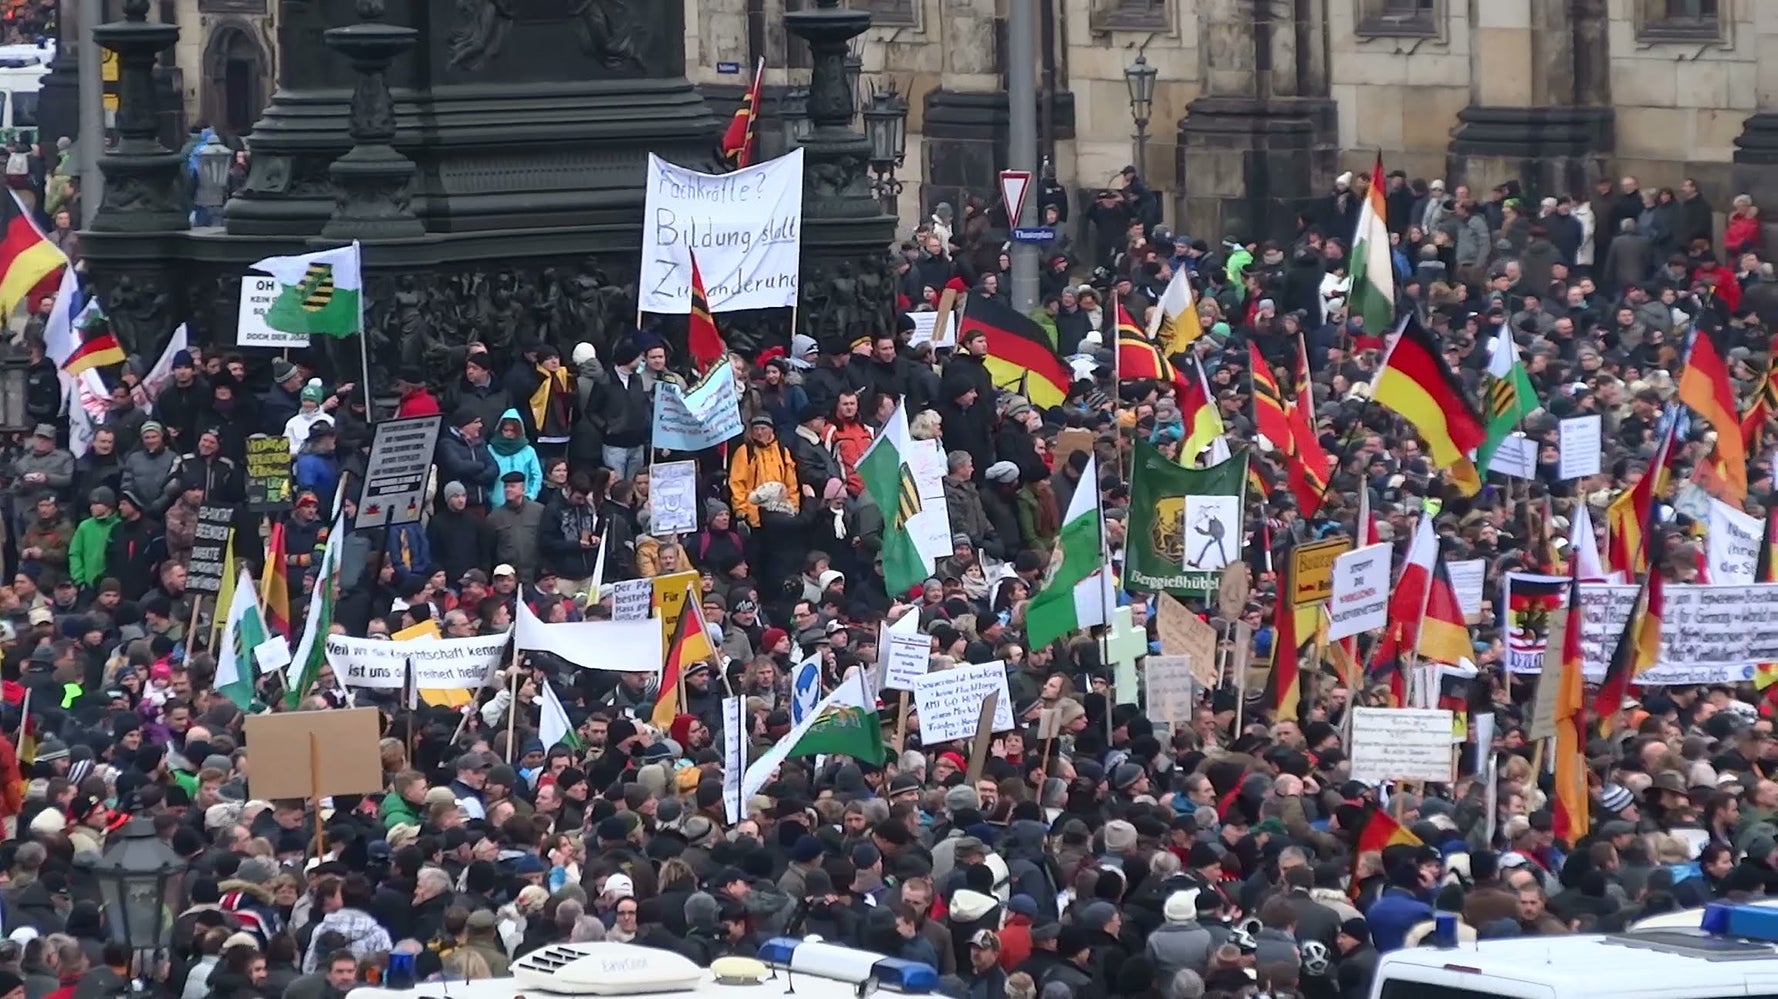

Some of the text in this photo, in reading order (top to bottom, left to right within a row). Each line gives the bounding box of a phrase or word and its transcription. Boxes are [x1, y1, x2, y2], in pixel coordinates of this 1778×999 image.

[656, 207, 752, 254] Bildung
[256, 280, 275, 291] OH
[651, 258, 798, 298] Zuanderung
[614, 582, 632, 593] Der
[1130, 569, 1220, 590] Berggießhübel
[663, 591, 679, 603] Für
[347, 662, 366, 678] ist
[369, 663, 391, 678] uns
